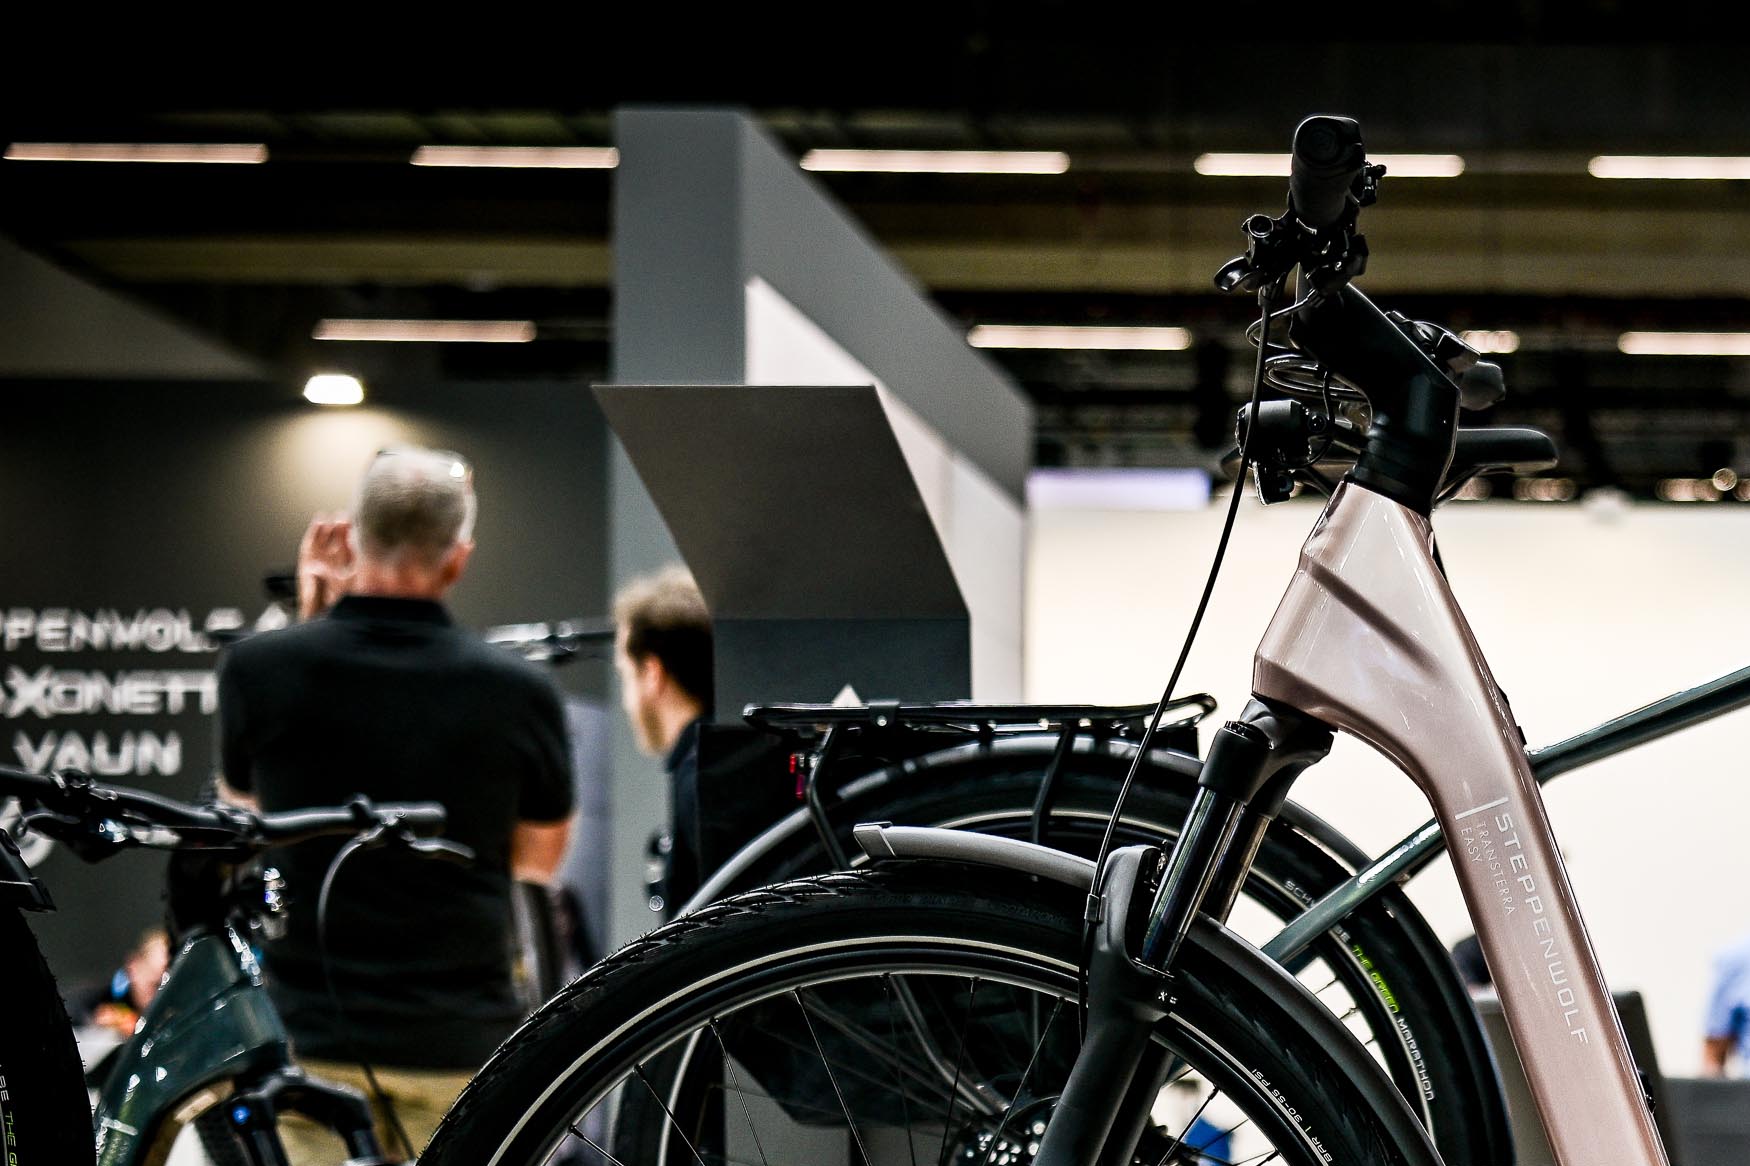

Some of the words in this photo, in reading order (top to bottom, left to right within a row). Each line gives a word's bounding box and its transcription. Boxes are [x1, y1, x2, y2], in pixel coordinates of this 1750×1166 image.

[13, 731, 182, 776] VAUN
[1461, 827, 1483, 863] EASY
[1475, 820, 1516, 916] TRANSTERRA
[1494, 812, 1589, 1044] STEPPENWOLF
[1396, 1017, 1435, 1101] MARATHON
[1252, 1068, 1271, 1087] PSI
[1271, 1089, 1303, 1123] 30-55
[3, 1111, 17, 1147] THE
[1311, 1136, 1333, 1162] BAR
